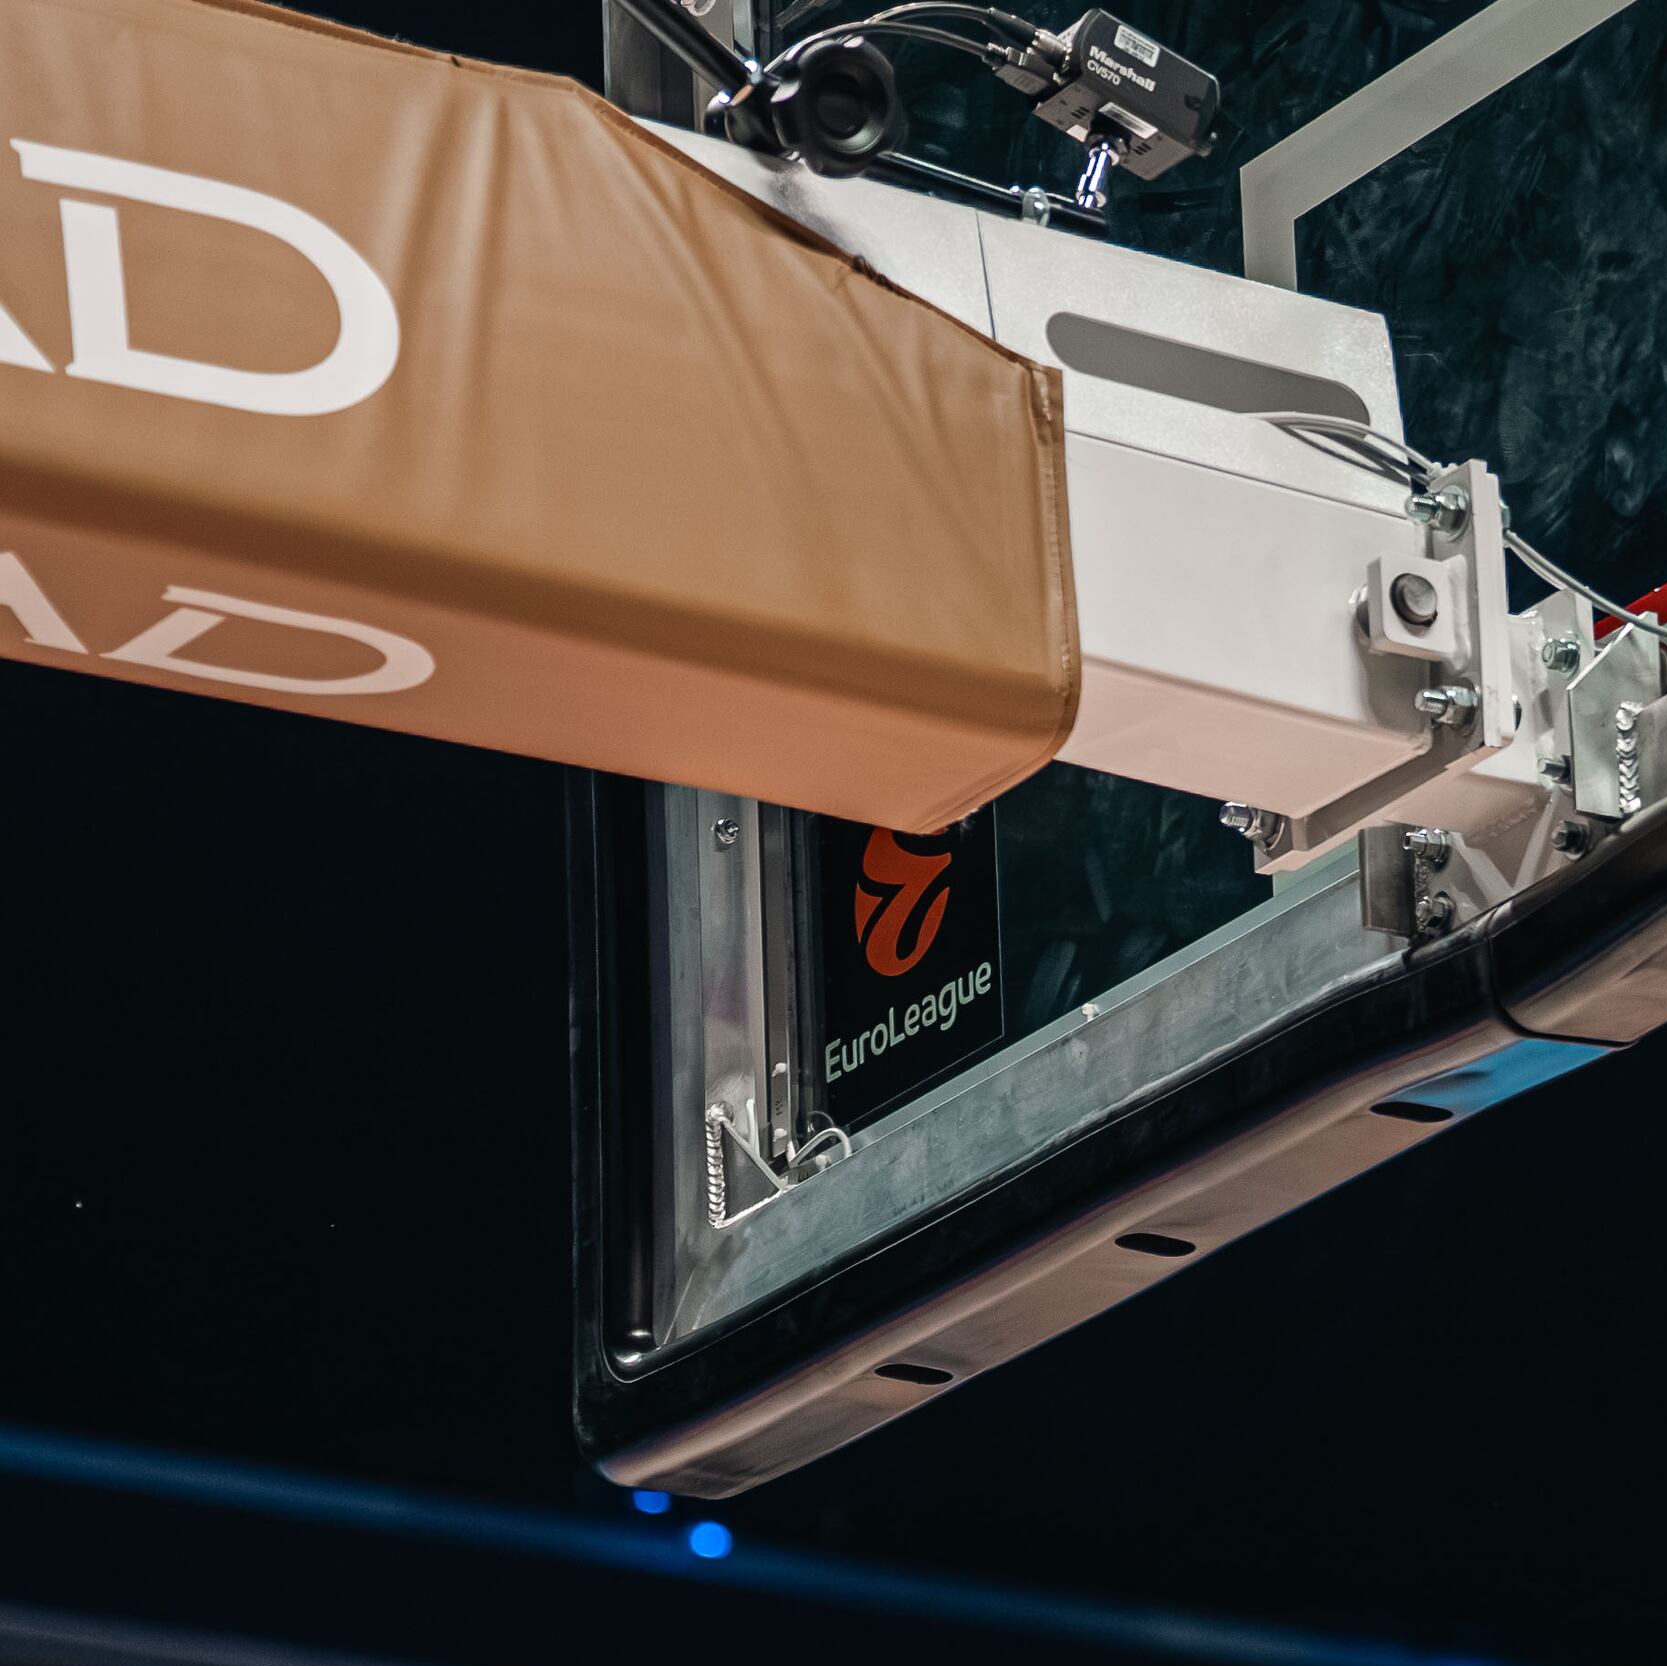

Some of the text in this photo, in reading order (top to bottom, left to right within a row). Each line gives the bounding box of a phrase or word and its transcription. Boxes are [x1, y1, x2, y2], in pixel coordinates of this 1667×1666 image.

[1087, 59, 1121, 86] CV570
[1089, 45, 1157, 92] Marshall
[0, 137, 400, 416] D
[825, 961, 992, 1084] EuroLeague
